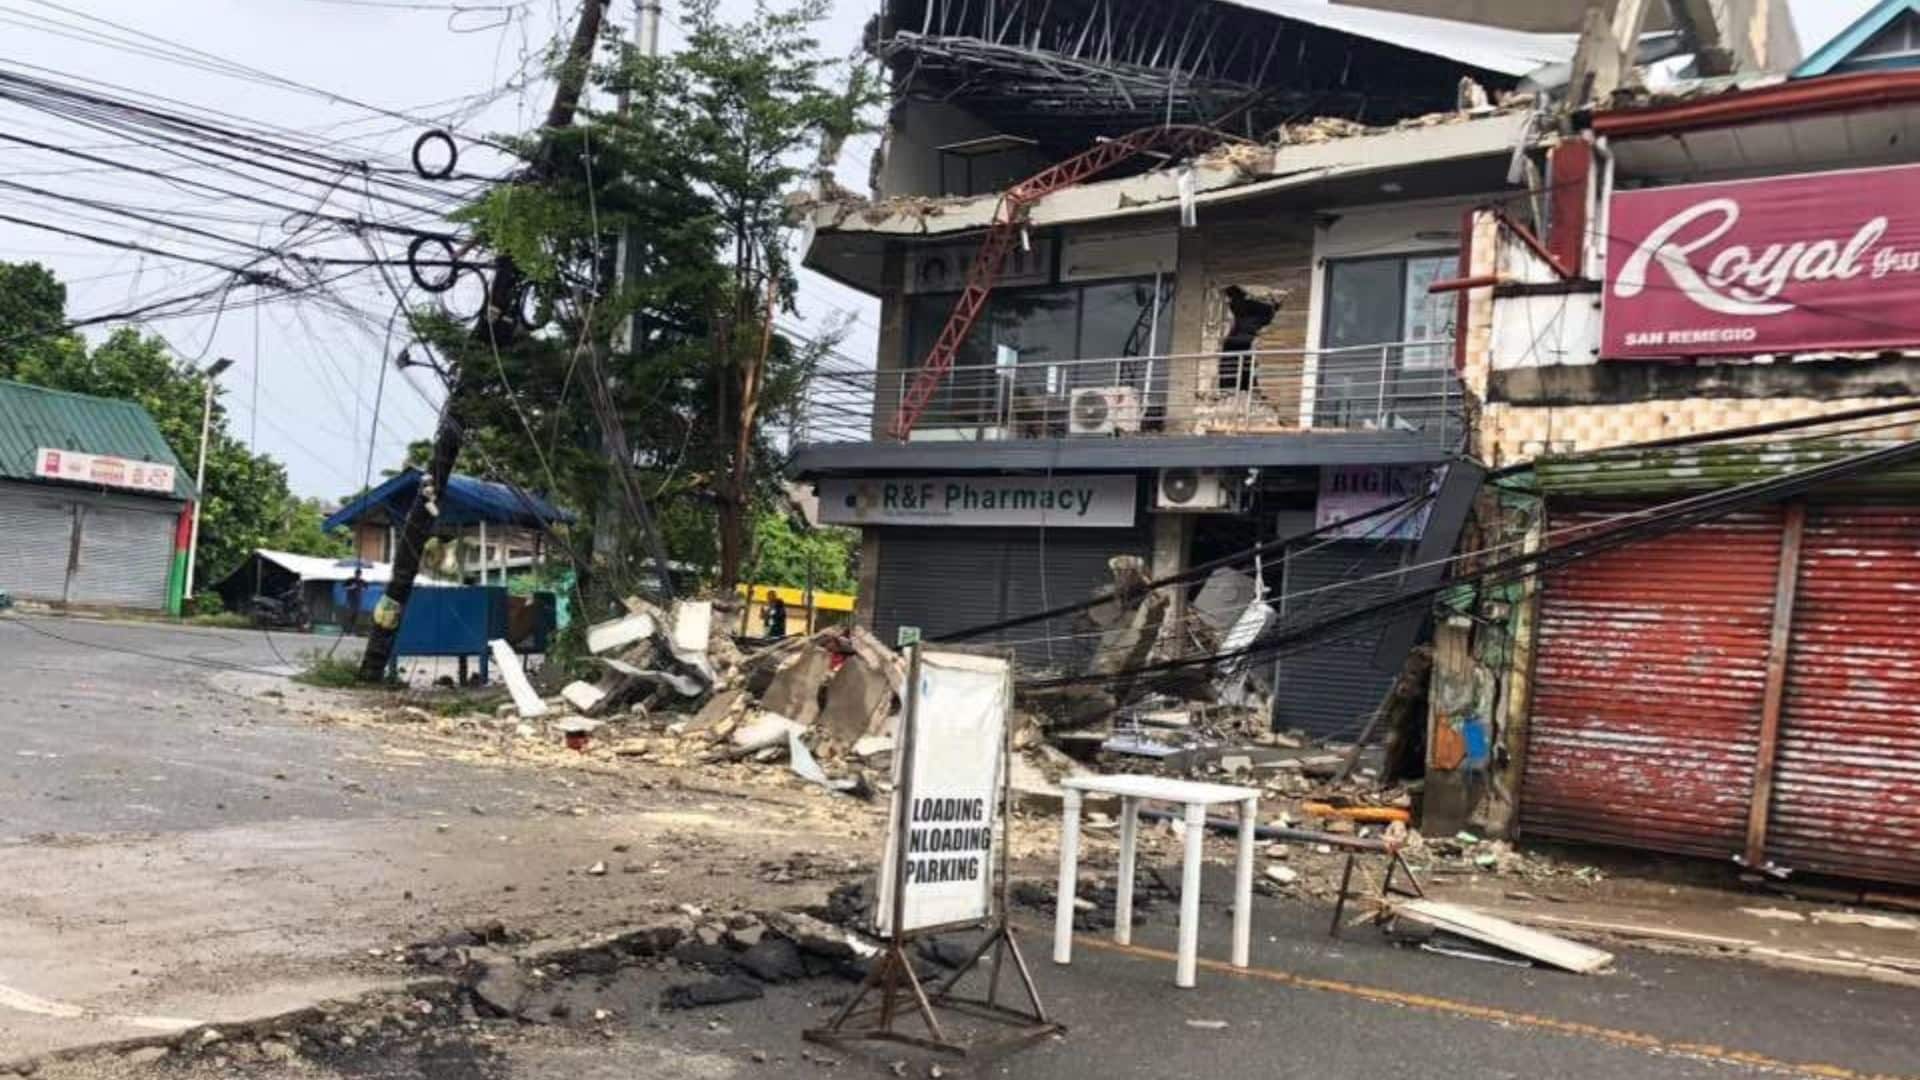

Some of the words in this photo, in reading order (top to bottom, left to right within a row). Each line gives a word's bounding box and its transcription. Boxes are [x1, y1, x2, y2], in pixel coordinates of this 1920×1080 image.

[1613, 198, 1888, 316] Royal
[1624, 331, 1663, 346] SAN
[1668, 327, 1757, 344] REMEGIO
[883, 483, 934, 510] R&F
[944, 483, 1093, 516] Pharmacy
[913, 798, 983, 822] LOADING
[910, 827, 991, 852] NLOADING
[904, 858, 979, 884] PARKING
